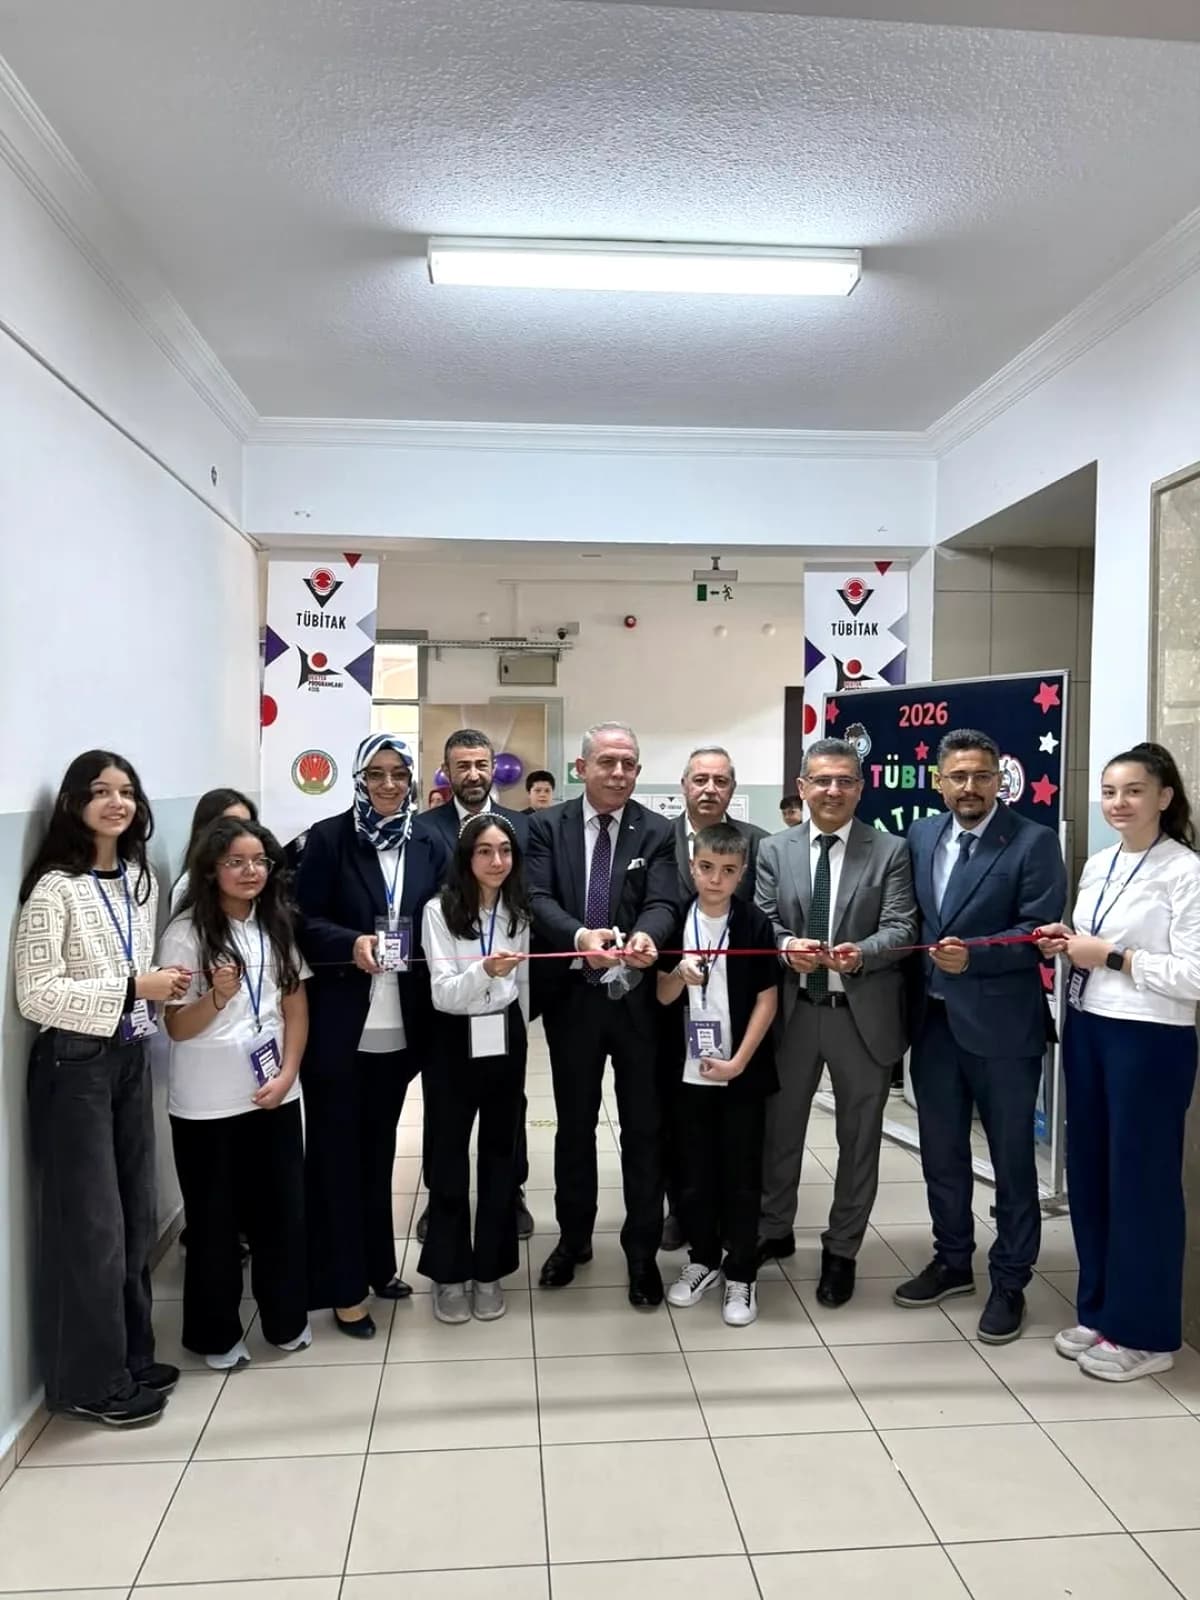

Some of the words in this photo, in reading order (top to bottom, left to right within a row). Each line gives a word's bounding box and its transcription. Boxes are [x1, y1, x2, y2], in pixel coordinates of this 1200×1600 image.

[296, 610, 346, 630] TÜBİTAK
[831, 620, 879, 636] TÜBİTAK
[899, 702, 948, 727] 2026
[871, 754, 940, 789] TÜBIT
